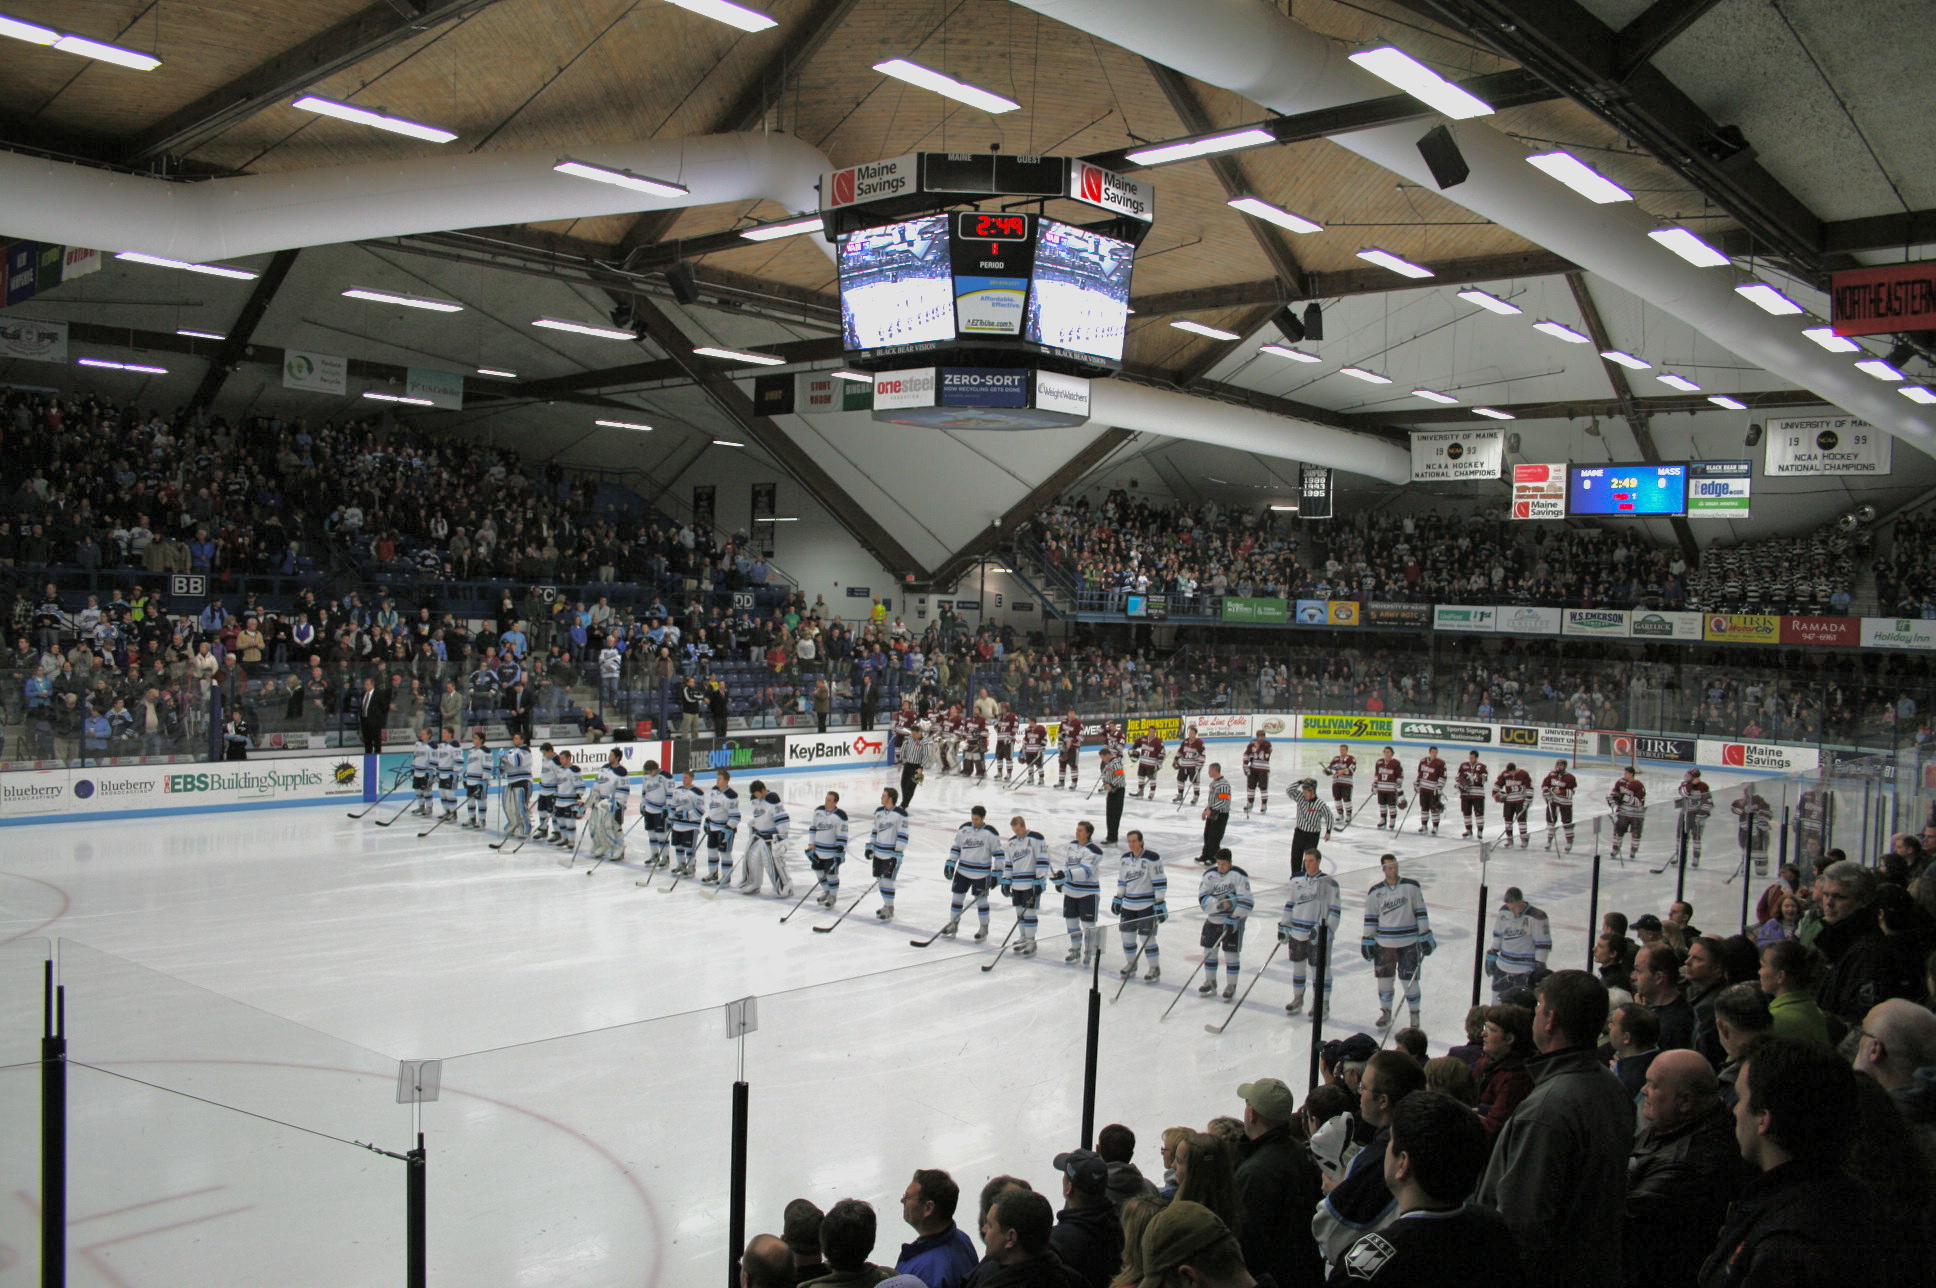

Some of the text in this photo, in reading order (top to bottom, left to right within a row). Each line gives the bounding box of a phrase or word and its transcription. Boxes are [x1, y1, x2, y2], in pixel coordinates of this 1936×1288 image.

[948, 153, 972, 161] MAINE
[1017, 155, 1041, 164] GUEST
[857, 162, 897, 181] Maine
[857, 176, 906, 196] Savings
[1104, 172, 1138, 195] Maine
[1104, 187, 1144, 213] Savings
[976, 215, 1023, 236] 2:49
[980, 261, 1004, 269] PERIOD
[876, 347, 897, 356] BLACK
[898, 345, 912, 354] BEAR
[913, 342, 936, 352] VISION
[1055, 349, 1072, 361] BLACK
[1072, 352, 1087, 362] BEAR
[1087, 354, 1106, 365] VISION
[877, 375, 934, 395] onesteel
[944, 374, 1020, 386] ZERO-SORT
[1780, 420, 1831, 429] UNIVERSITY
[1834, 420, 1847, 428] OF
[1476, 431, 1498, 439] MAINE
[1789, 437, 1799, 446] 19
[1854, 435, 1867, 444] 99
[1436, 448, 1444, 456] 19
[1467, 447, 1476, 455] 93
[1794, 452, 1859, 461] NCAA HOCKEY
[1453, 461, 1484, 469] HOCKEY
[1778, 463, 1875, 472] NATIONAL CHAMPIONS
[1454, 469, 1496, 477] CHAMPIONS
[1581, 469, 1603, 477] MAINE
[1657, 467, 1680, 476] MASS
[1610, 477, 1638, 488] 2:49
[1531, 501, 1558, 509] Maine
[1531, 508, 1563, 518] Savings
[174, 577, 203, 593] BB
[1585, 612, 1624, 623] EMERSON
[1634, 622, 1671, 630] GARELICK
[1791, 620, 1848, 632] RAMADA
[1874, 631, 1931, 644] Holiday Inn
[1127, 719, 1140, 730] JOE
[1198, 715, 1247, 727] Bee Line Cable
[1303, 718, 1393, 730] SULLIVAN TIRE
[1447, 726, 1489, 736] Sports Signage
[1451, 733, 1485, 741] Nationwide
[1501, 728, 1537, 743] UCU
[1545, 729, 1585, 737] UNIVERSITY
[570, 747, 607, 764] nthem
[789, 741, 851, 762] KeyBank
[1746, 745, 1783, 757] Maine
[1745, 755, 1791, 769] Savings
[101, 780, 156, 792] blueberry
[171, 772, 210, 793] EBS
[4, 785, 63, 799] blueberry
[963, 838, 985, 849] Maine
[1141, 860, 1147, 869] C
[1124, 869, 1144, 882] Maine
[1212, 883, 1235, 895] Maine
[1381, 896, 1406, 913] Maine
[1502, 926, 1527, 939] Maine
